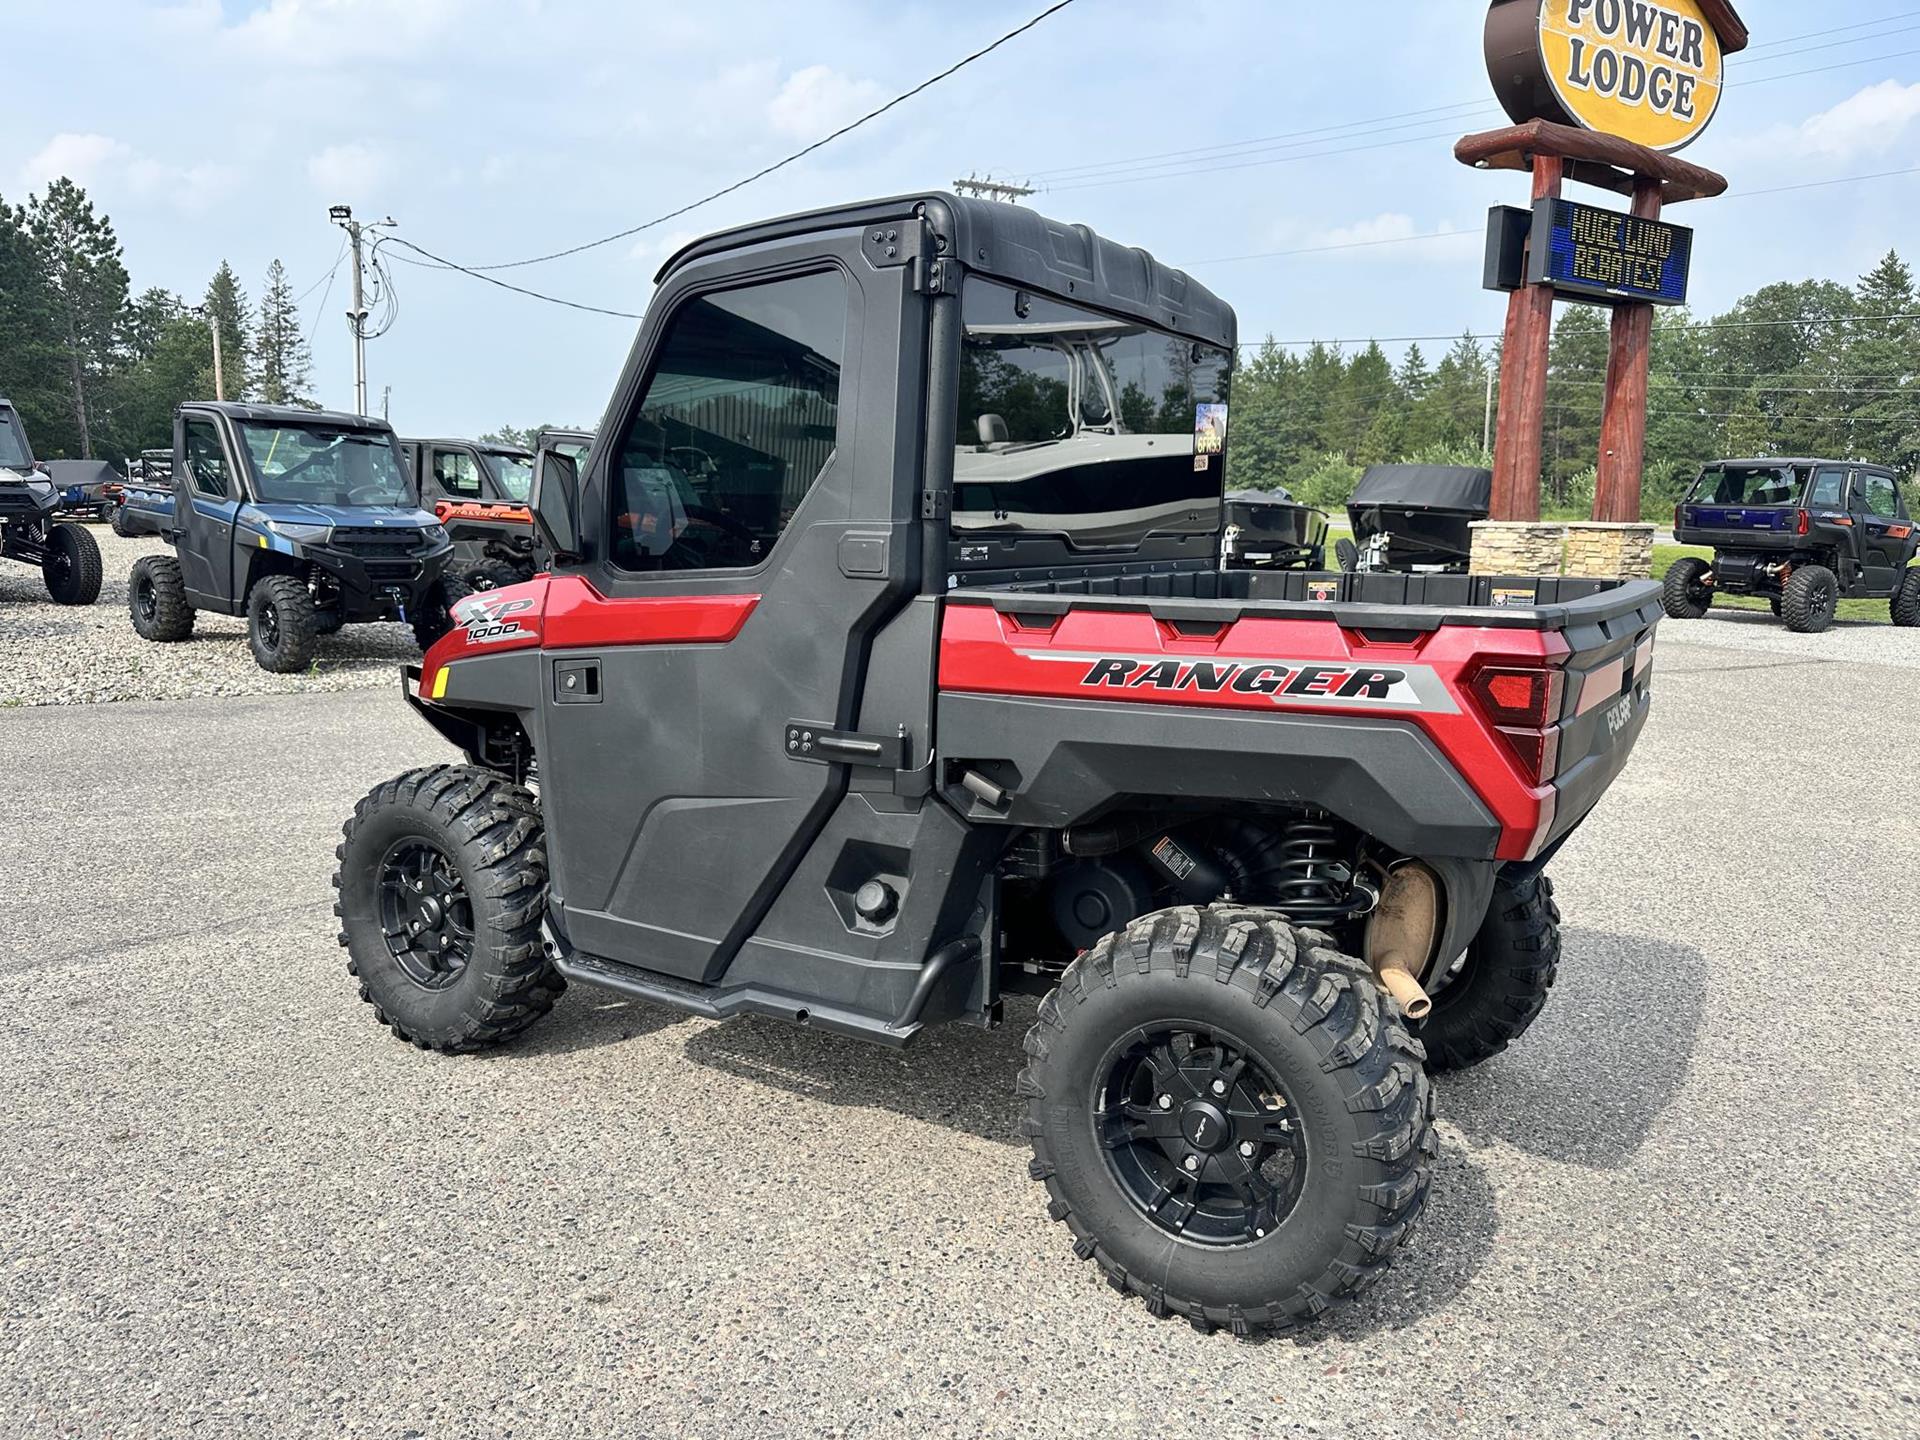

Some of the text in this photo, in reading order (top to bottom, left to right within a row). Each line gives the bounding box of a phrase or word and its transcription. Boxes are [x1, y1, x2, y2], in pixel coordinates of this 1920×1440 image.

[1568, 0, 1703, 68] POWER
[1568, 38, 1695, 118] LODGE
[1571, 208, 1621, 249] HUGE
[460, 598, 534, 628] XP
[467, 622, 520, 640] 1000
[1081, 657, 1407, 699] RANGER
[1606, 693, 1632, 735] POLAR
